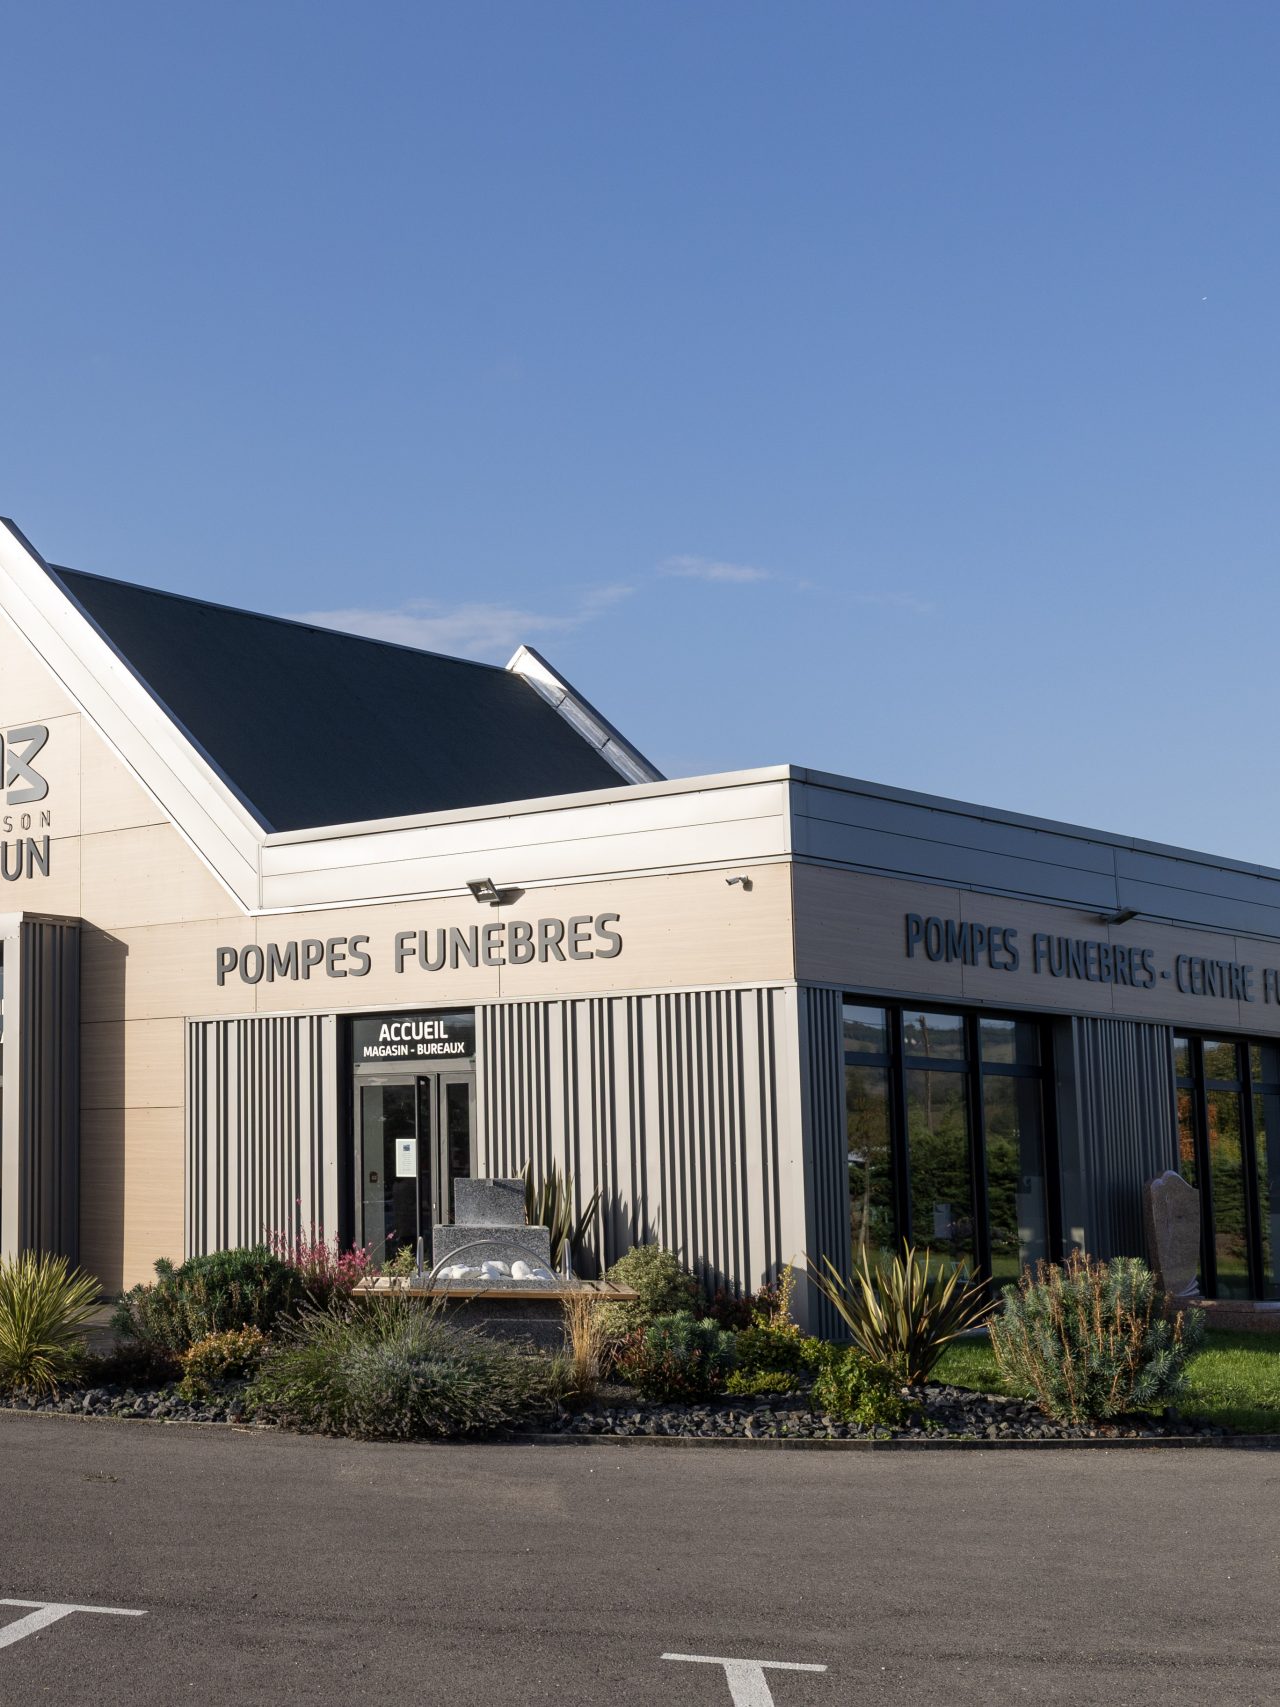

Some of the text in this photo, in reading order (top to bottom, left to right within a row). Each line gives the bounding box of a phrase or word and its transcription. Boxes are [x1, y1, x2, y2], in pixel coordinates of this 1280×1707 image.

[216, 913, 623, 986] POMPES FUNEBRES
[905, 912, 1019, 972] POMPES
[1033, 933, 1157, 989] FUNEBRES
[1176, 954, 1255, 1002] CENTRE
[363, 1044, 409, 1058] MAGASIN
[416, 1042, 465, 1056] BUREAUX
[378, 1020, 449, 1042] ACCUEIL
